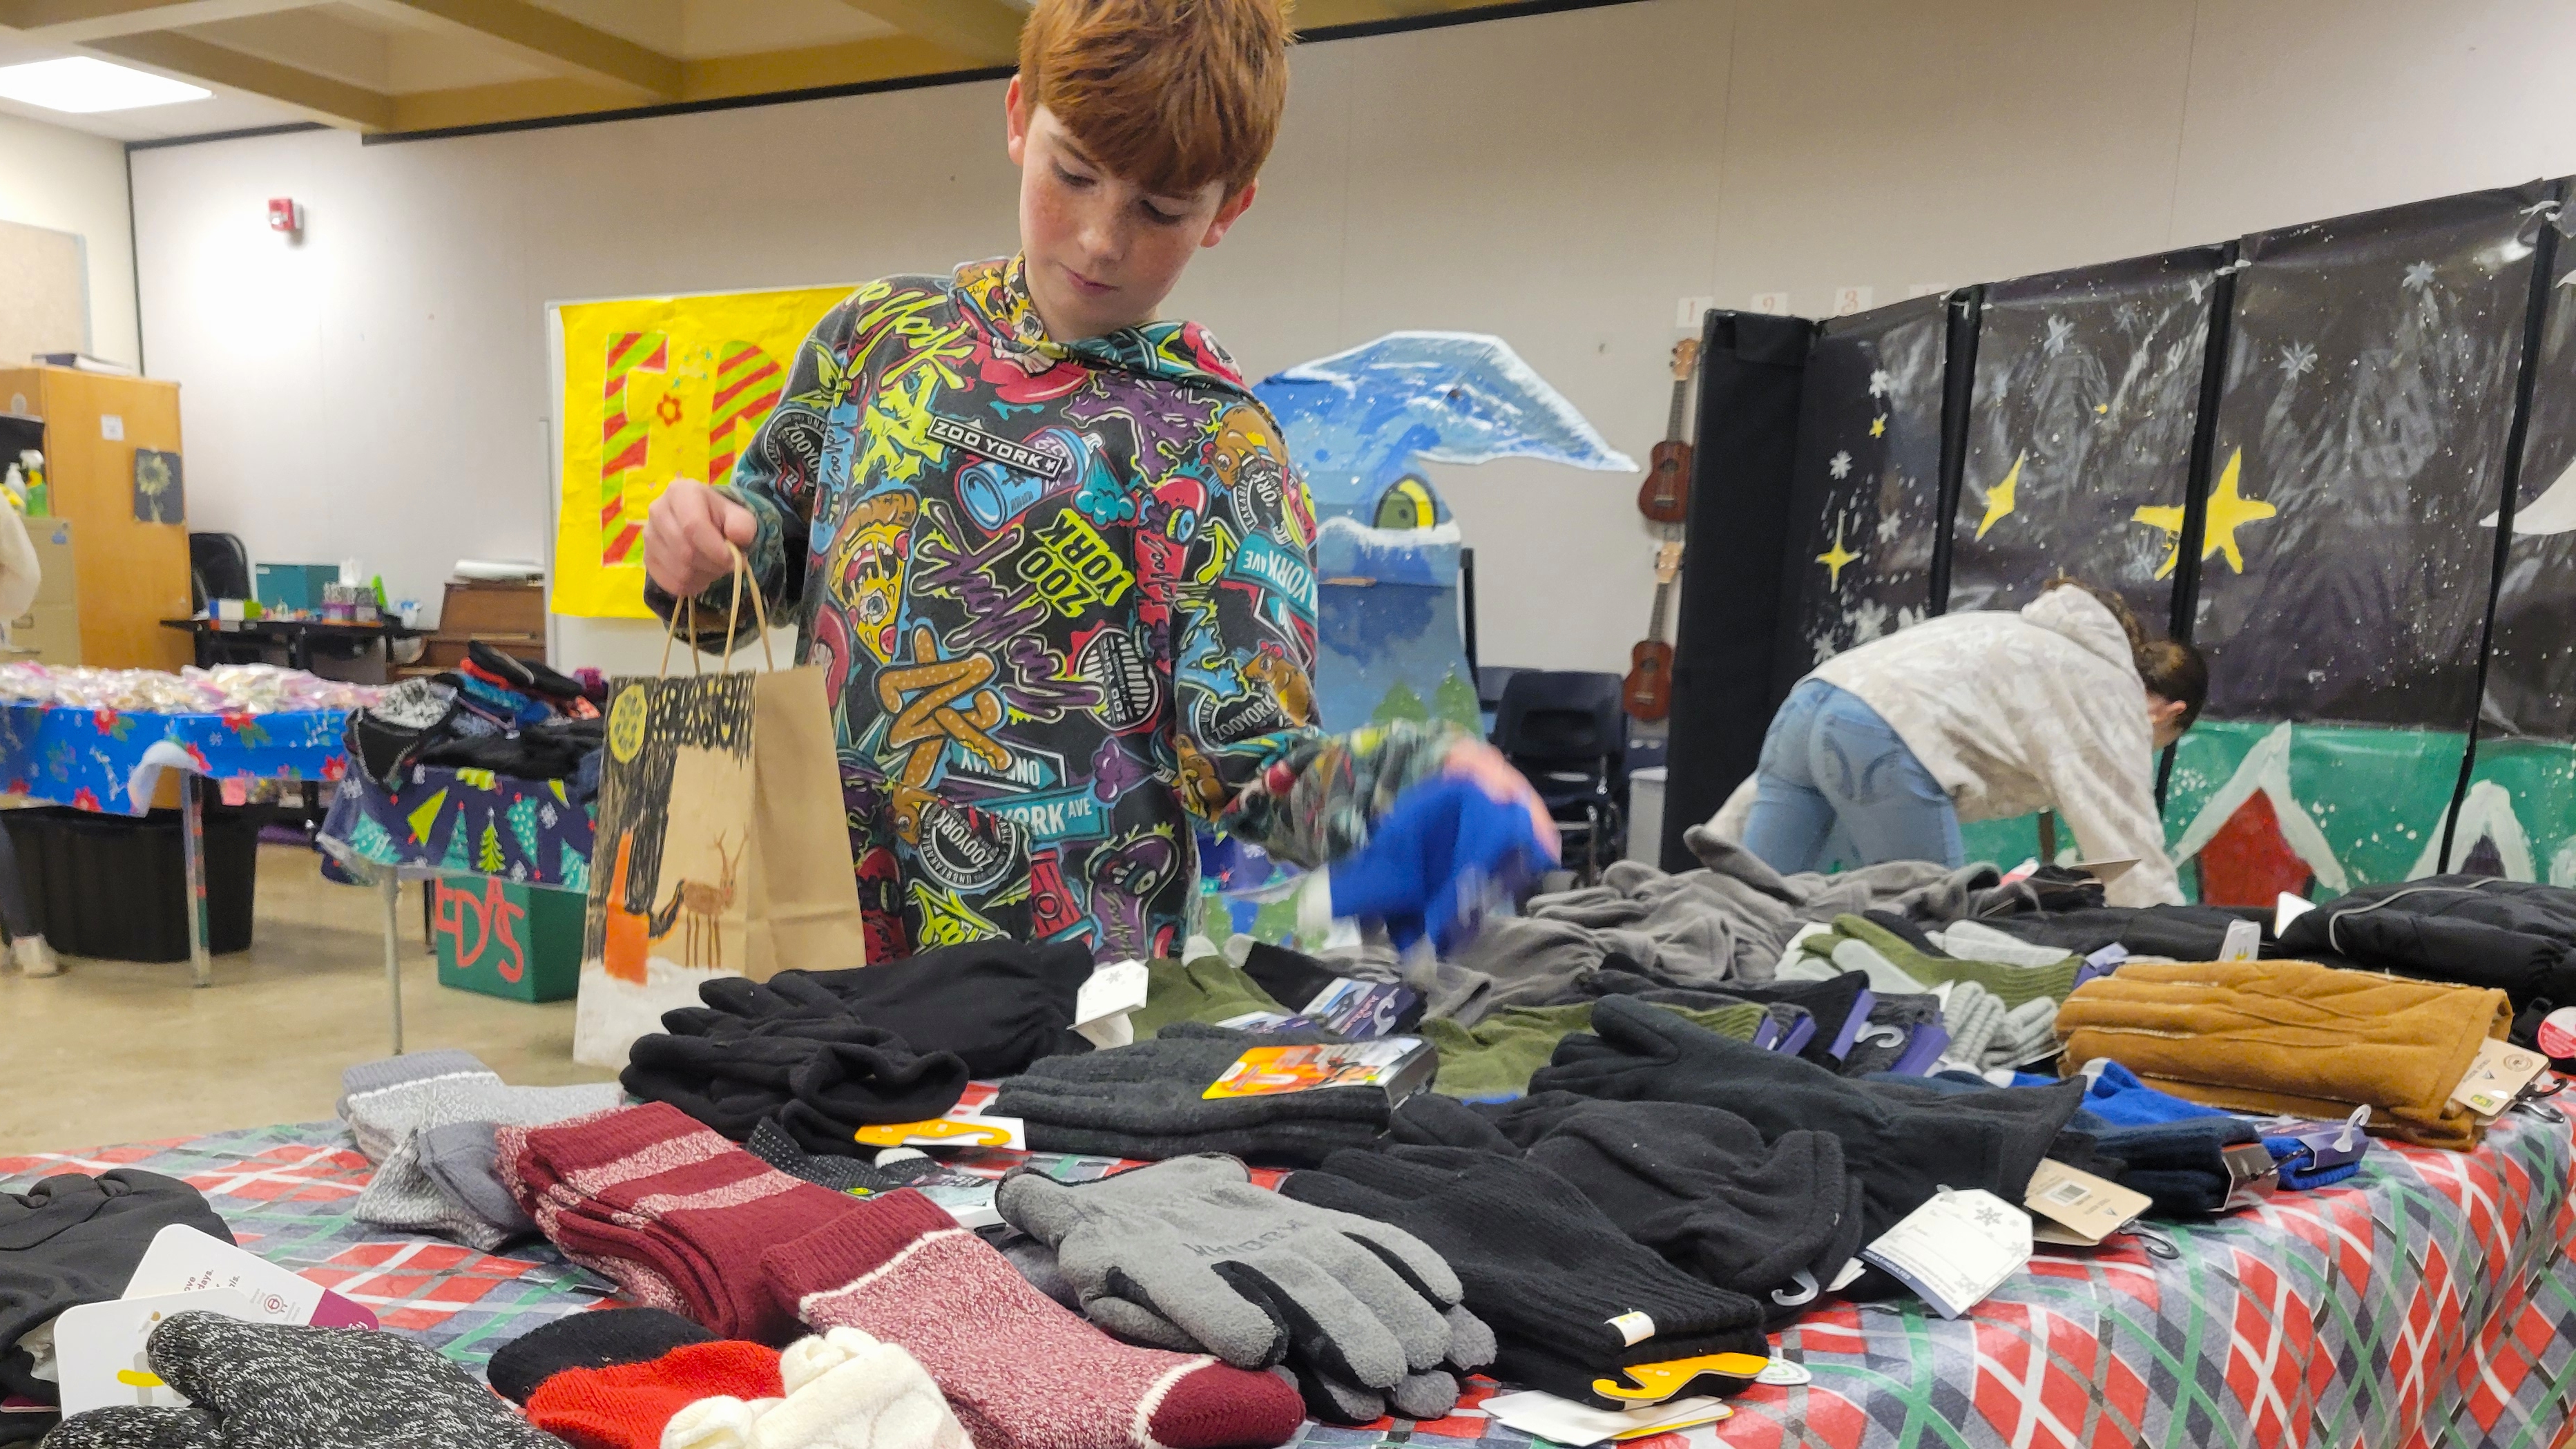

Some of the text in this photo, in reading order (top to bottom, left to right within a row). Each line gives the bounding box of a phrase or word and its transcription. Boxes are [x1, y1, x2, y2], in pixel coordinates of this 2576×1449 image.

[1841, 290, 1858, 314] 3
[932, 421, 981, 446] ZOO
[986, 439, 1043, 469] YORK
[1021, 550, 1094, 612] ZOO
[1034, 515, 1128, 598] YORK
[1267, 550, 1311, 604] YORK
[1211, 694, 1278, 741] ZOOYORK
[1068, 797, 1093, 820] AVE
[934, 809, 994, 869] ZOOYORK
